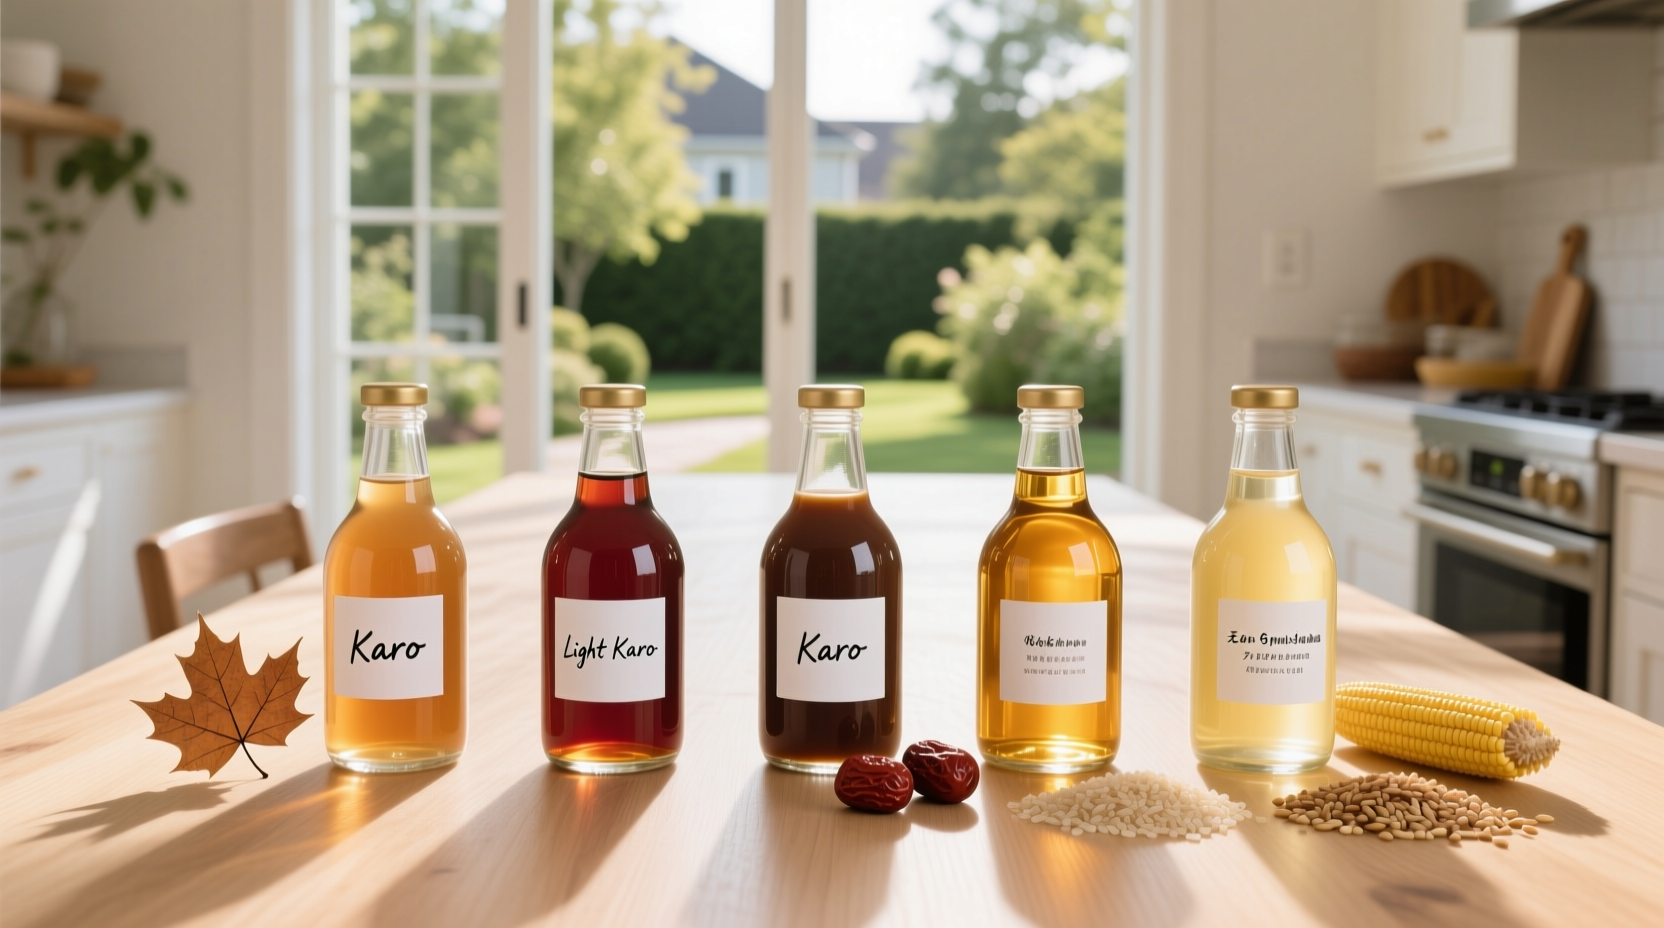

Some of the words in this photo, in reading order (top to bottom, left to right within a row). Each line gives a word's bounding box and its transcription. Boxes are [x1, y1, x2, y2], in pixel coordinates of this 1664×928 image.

[350, 628, 427, 665] Karo
[563, 634, 608, 670] Light
[612, 635, 659, 661] Karo
[796, 631, 869, 666] Karo
